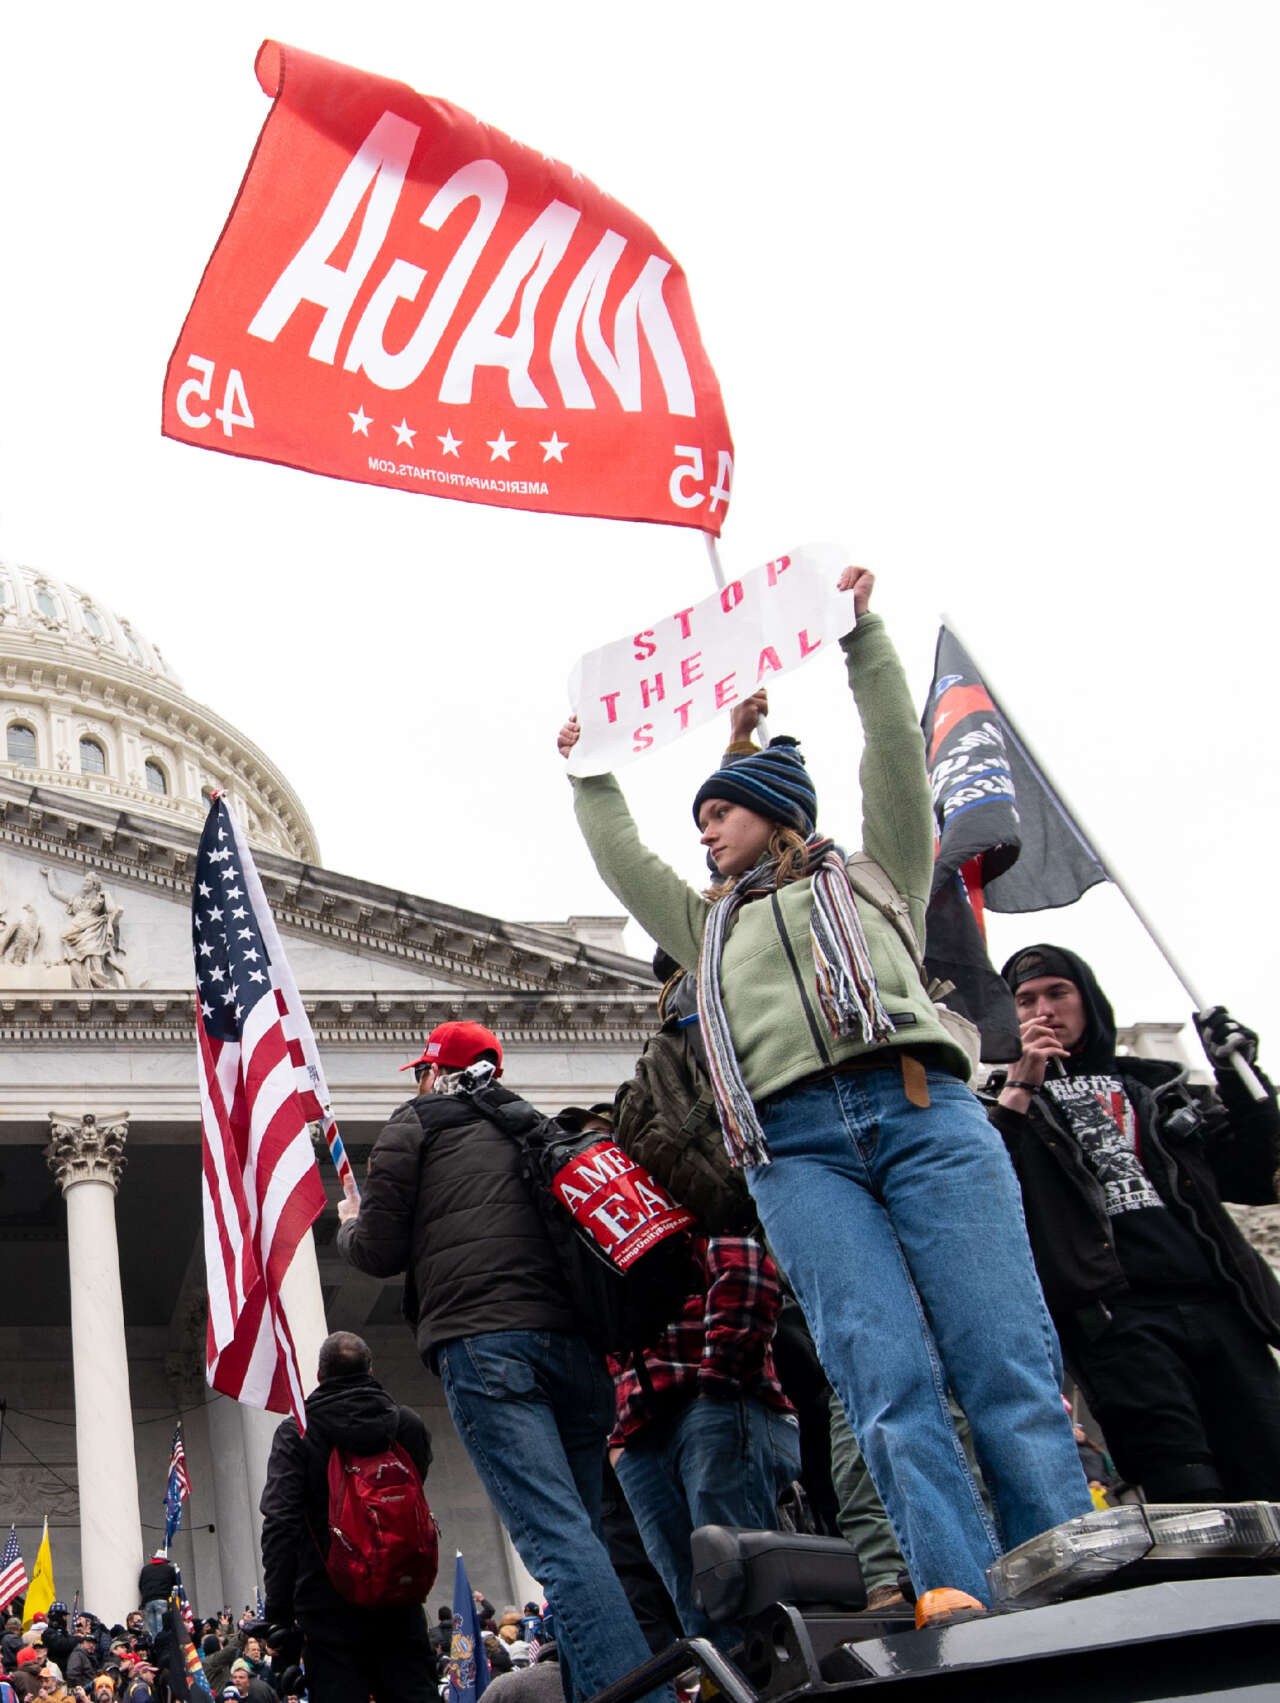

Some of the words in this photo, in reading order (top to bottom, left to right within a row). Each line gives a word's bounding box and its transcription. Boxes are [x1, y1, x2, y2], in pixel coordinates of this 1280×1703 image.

[633, 555, 791, 661] STOP
[600, 651, 704, 723] THE
[632, 629, 822, 752] STEAL
[560, 1147, 639, 1214] AME
